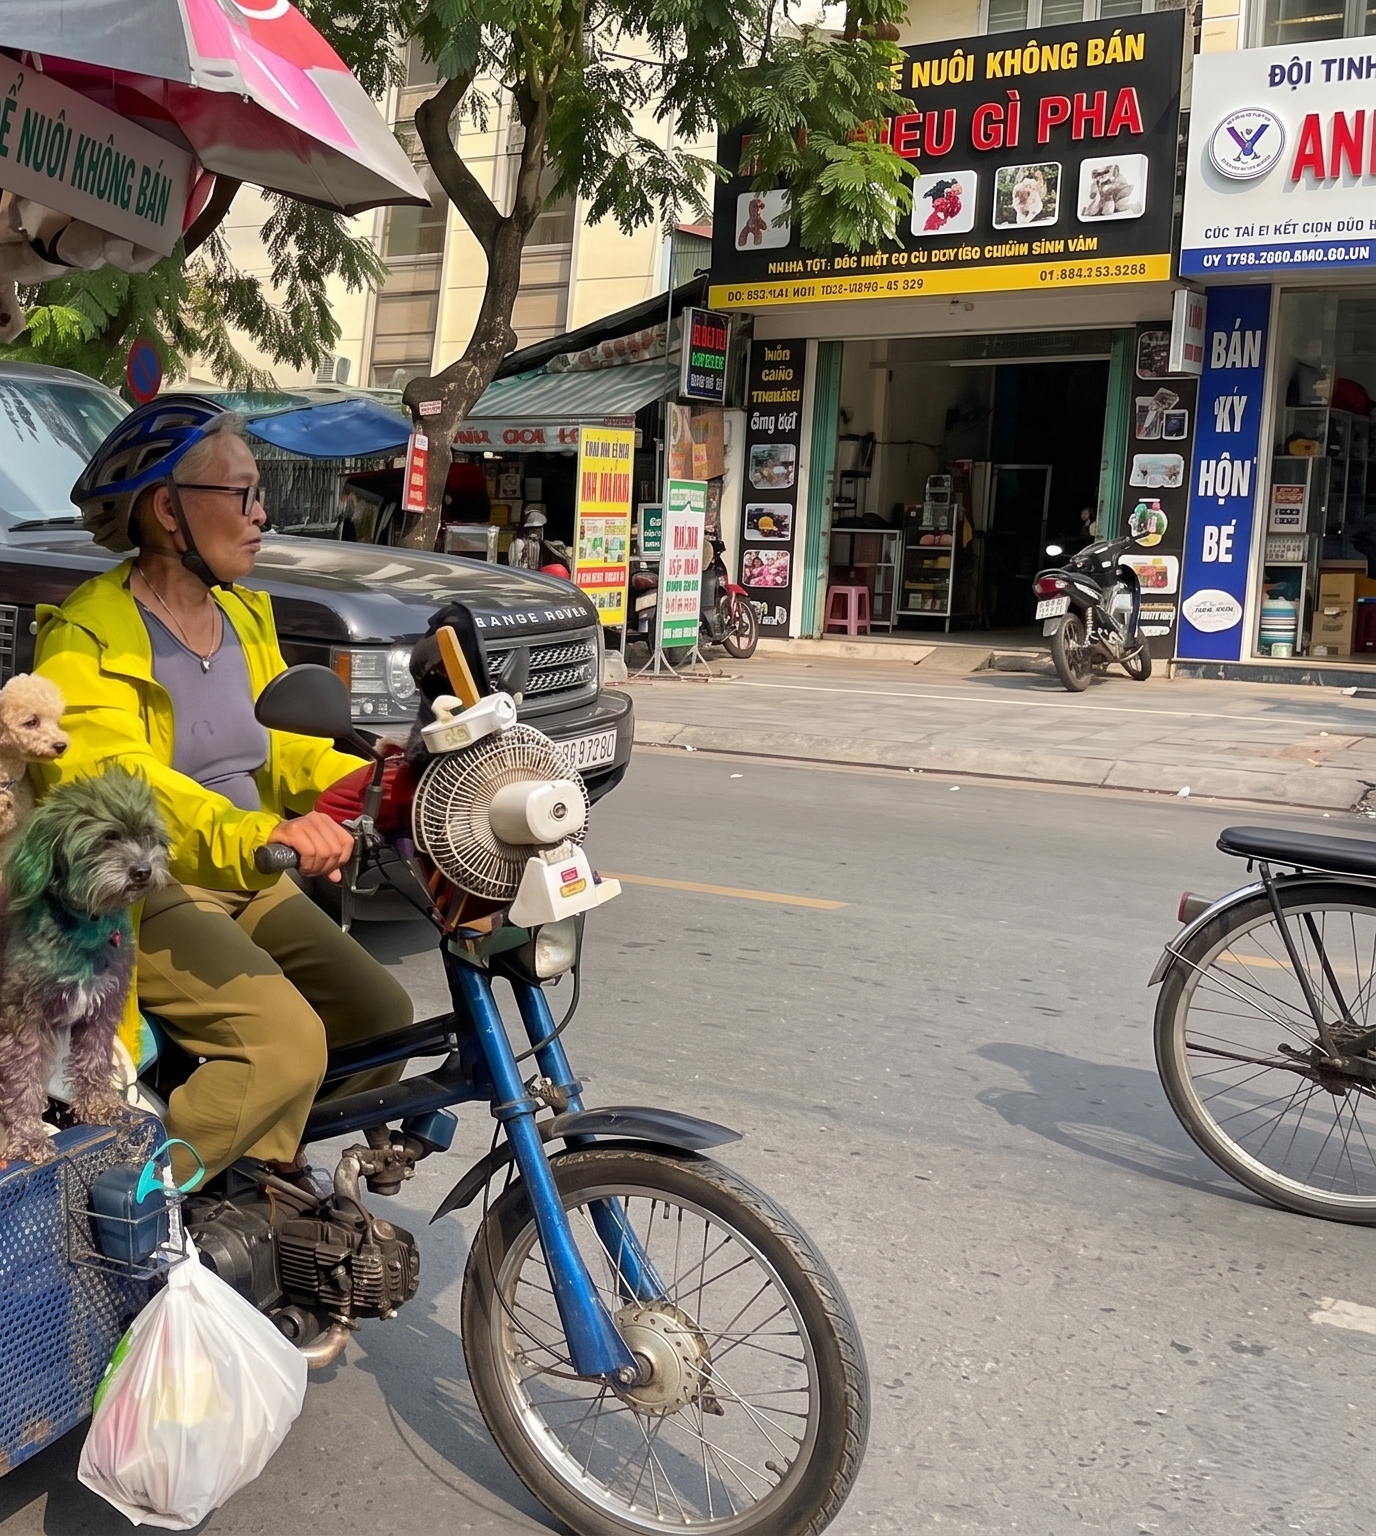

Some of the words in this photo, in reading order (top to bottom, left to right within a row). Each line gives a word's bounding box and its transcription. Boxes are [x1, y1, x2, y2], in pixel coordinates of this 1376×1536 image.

[912, 48, 973, 89] NUÔI
[985, 39, 1079, 82] KHÔNG
[1086, 28, 1145, 68] BÁN
[1268, 55, 1312, 91] ĐỘI
[971, 90, 1020, 151] GÌ
[1037, 86, 1144, 144] PHA
[16, 108, 72, 184] NUÔI
[71, 133, 136, 212] KHÔNG
[137, 160, 173, 227] BÁN
[1210, 318, 1262, 369] BÁN
[1202, 519, 1237, 563] BÉ
